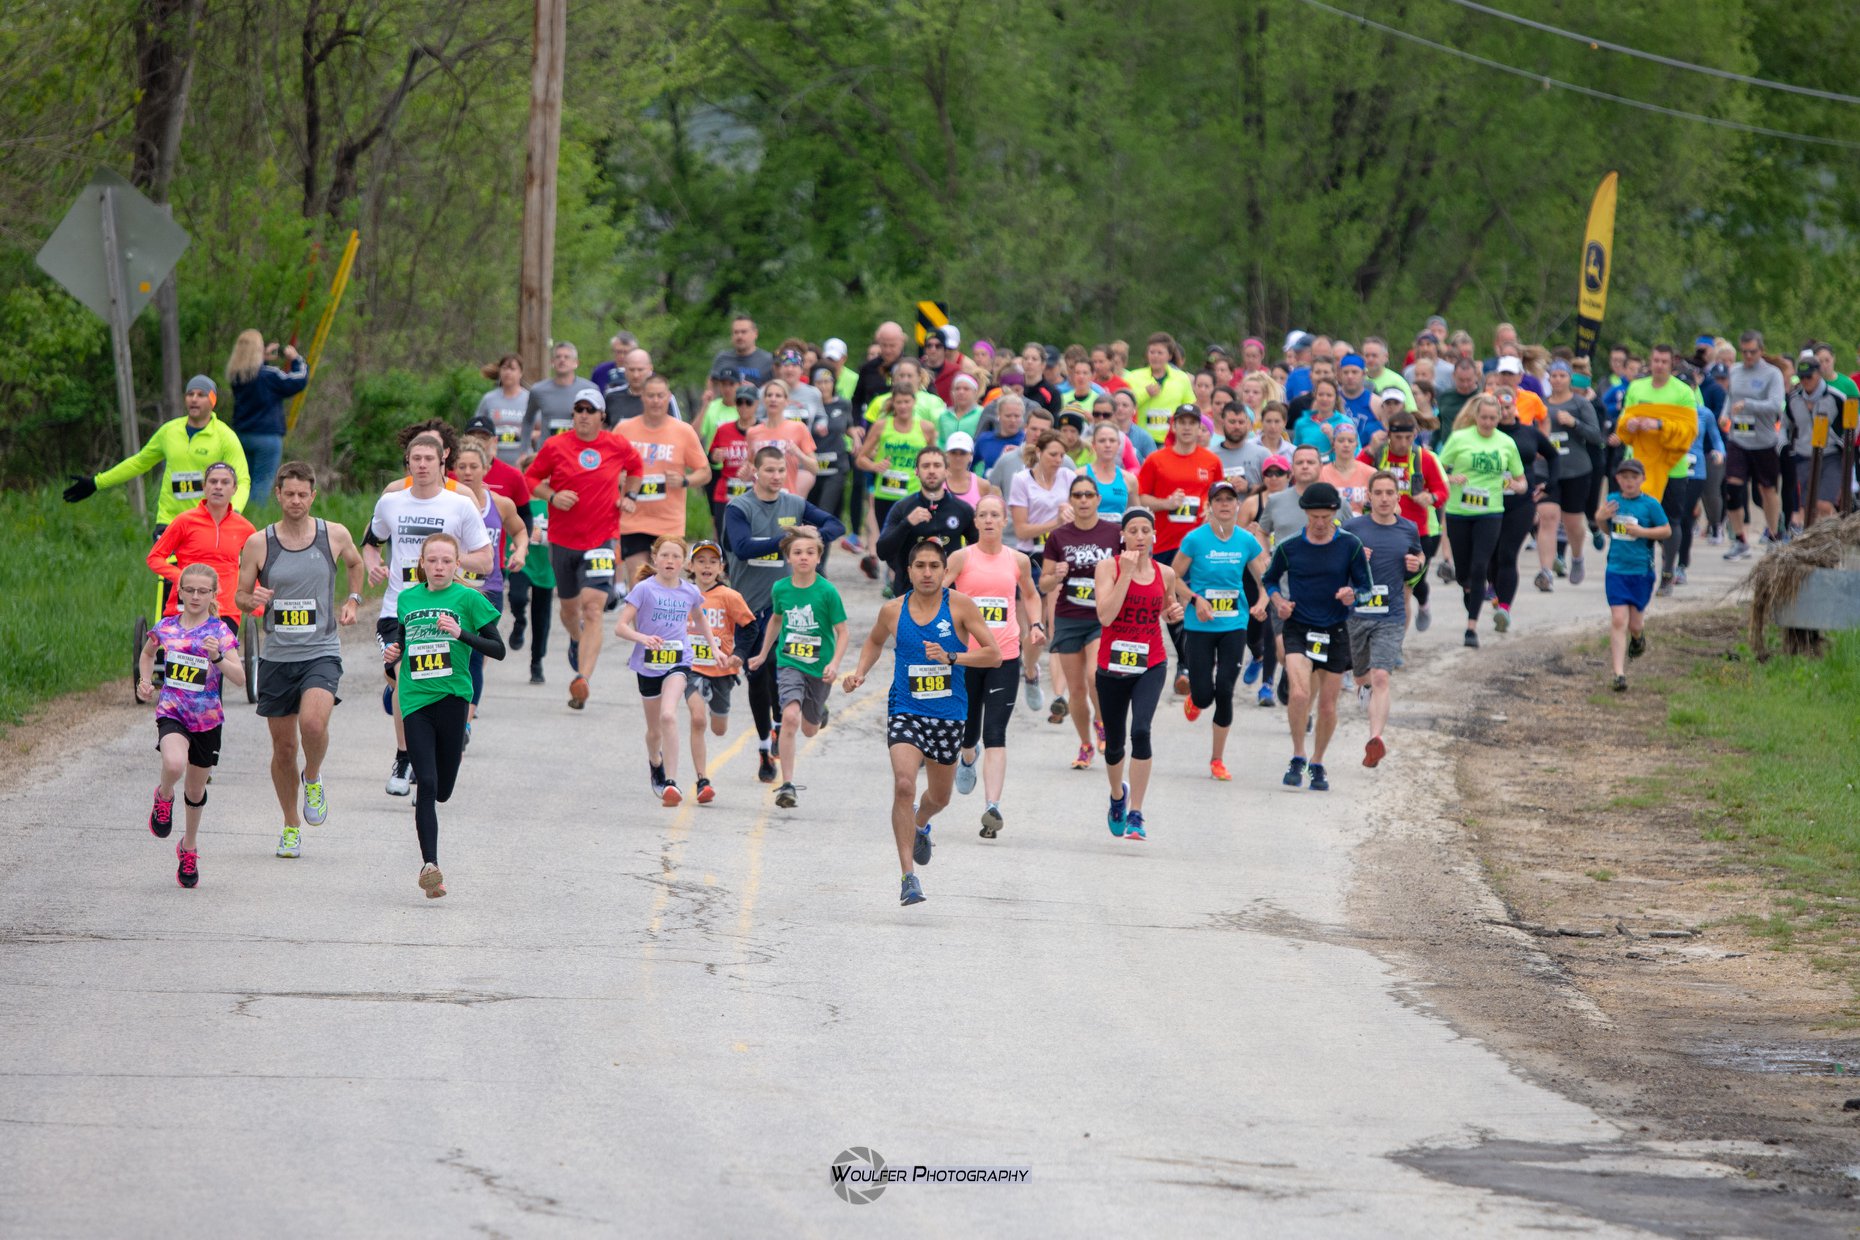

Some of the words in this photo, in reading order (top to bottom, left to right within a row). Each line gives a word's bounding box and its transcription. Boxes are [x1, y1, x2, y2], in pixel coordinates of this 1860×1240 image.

[180, 481, 194, 492] 91
[643, 483, 658, 495] 42
[398, 516, 444, 526] UNDER
[1075, 548, 1112, 565] PAM
[1076, 586, 1093, 599] 37
[1211, 598, 1234, 611] 102
[282, 610, 309, 625] 180
[789, 643, 814, 658] 153
[1312, 642, 1322, 654] 6
[416, 653, 445, 672] 144
[651, 649, 677, 664] 190
[1119, 651, 1138, 666] 83
[171, 663, 199, 683] 147
[916, 676, 945, 692] 198
